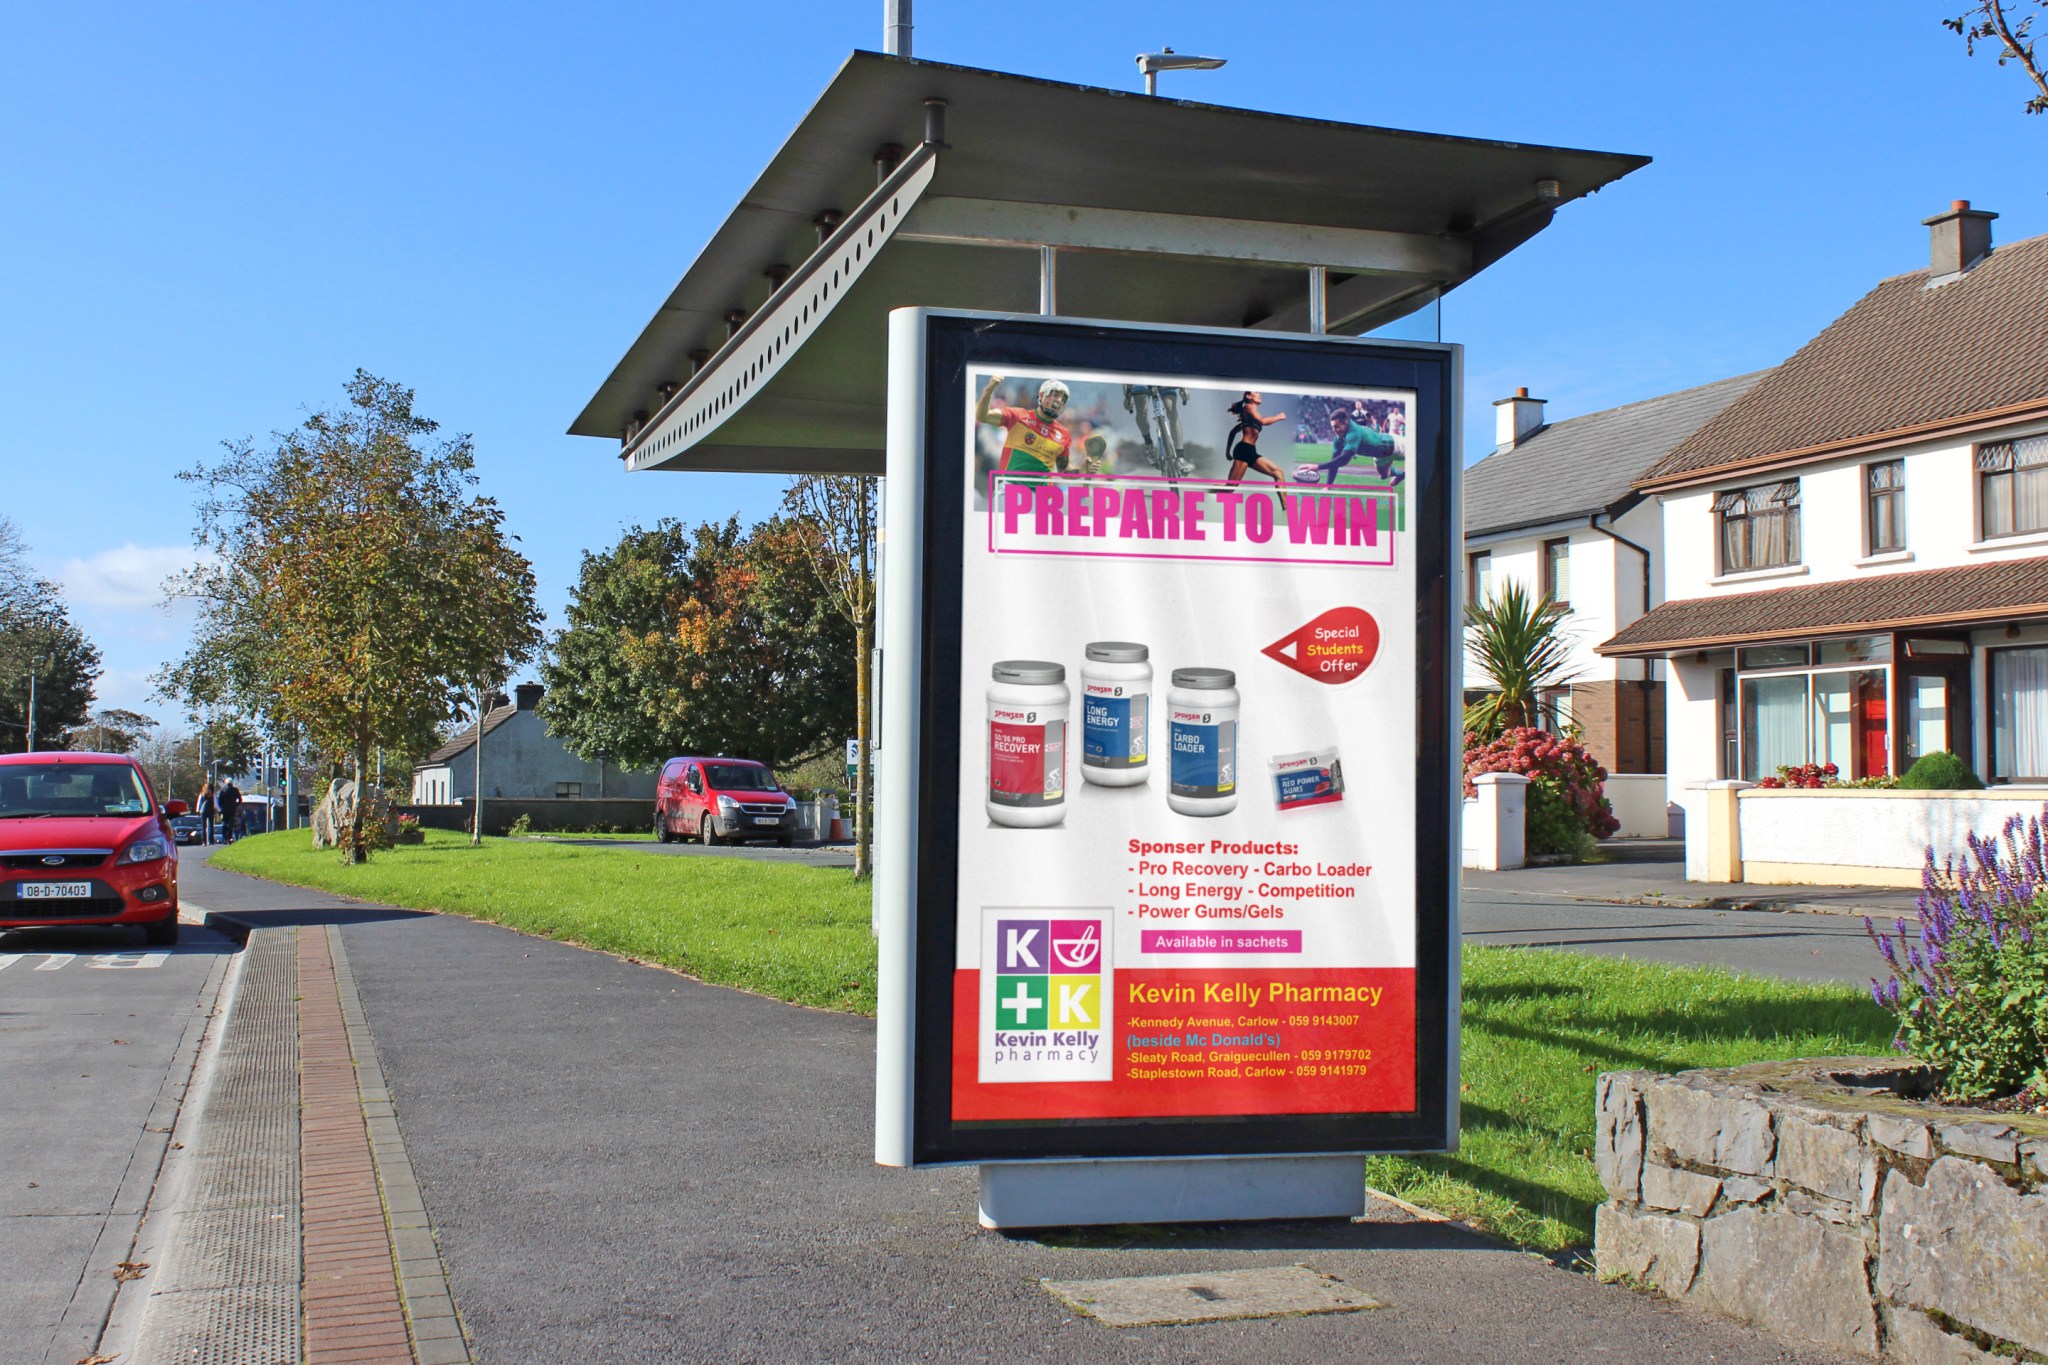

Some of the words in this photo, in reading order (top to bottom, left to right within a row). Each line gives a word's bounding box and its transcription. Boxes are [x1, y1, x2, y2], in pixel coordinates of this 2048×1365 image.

[1004, 484, 1206, 541] PREPARE
[1216, 492, 1274, 544] TO
[1286, 495, 1378, 547] WIN
[1315, 625, 1359, 642] Special
[1307, 642, 1364, 656] Students
[1320, 659, 1358, 672] Offer
[1087, 685, 1112, 693] SPONSER
[994, 710, 1024, 720] SPONSER
[1087, 705, 1108, 717] LONG
[1174, 711, 1200, 720] SPONSER
[1087, 714, 1119, 727] ENERGY
[1012, 736, 1026, 744] PRO
[1174, 733, 1200, 744] CARBO
[994, 741, 1040, 754] RECOVERY
[1174, 742, 1205, 753] LOADER
[1282, 780, 1296, 788] RED
[1296, 775, 1320, 786] POWER
[1283, 785, 1304, 795] GUMS
[1128, 838, 1205, 857] Sponser
[1210, 839, 1299, 855] Products:
[1139, 860, 1167, 876] Pro
[1172, 860, 1248, 879] Recovery
[1264, 861, 1312, 877] Carbo
[1317, 862, 1372, 877] Loader
[27, 884, 87, 897] 08-D-70403
[1139, 882, 1180, 900] Long
[1185, 882, 1243, 900] Energy
[1258, 882, 1355, 900] Competition
[1138, 904, 1190, 918] Power
[1195, 903, 1284, 919] Gums/Gels
[1006, 929, 1040, 967] K
[1156, 935, 1217, 948] Available
[1221, 936, 1233, 948] in
[1237, 935, 1288, 948] sachets
[1129, 983, 1195, 1003] Kevin
[1204, 982, 1261, 1007] Kelly
[1269, 982, 1382, 1007] Pharmacy
[1059, 984, 1092, 1023] K
[1187, 1016, 1234, 1028] Avenue,
[1237, 1016, 1278, 1026] Carlow
[1289, 1015, 1309, 1026] 059
[1312, 1015, 1359, 1026] 9143007
[995, 1032, 1046, 1047] Kevin
[1053, 1030, 1099, 1049] Kelly
[1127, 1034, 1181, 1050] (beside
[1186, 1034, 1207, 1047] Mc
[995, 1048, 1098, 1064] pharmacy
[1171, 1051, 1205, 1064] Road,
[1209, 1050, 1290, 1065] Graiguecullen
[1301, 1050, 1321, 1061] 059
[1324, 1049, 1371, 1061] 9179702
[1207, 1066, 1241, 1079] Road,
[1245, 1066, 1286, 1077] Carlow
[1296, 1065, 1317, 1076] 059
[1319, 1065, 1367, 1076] 9141979
